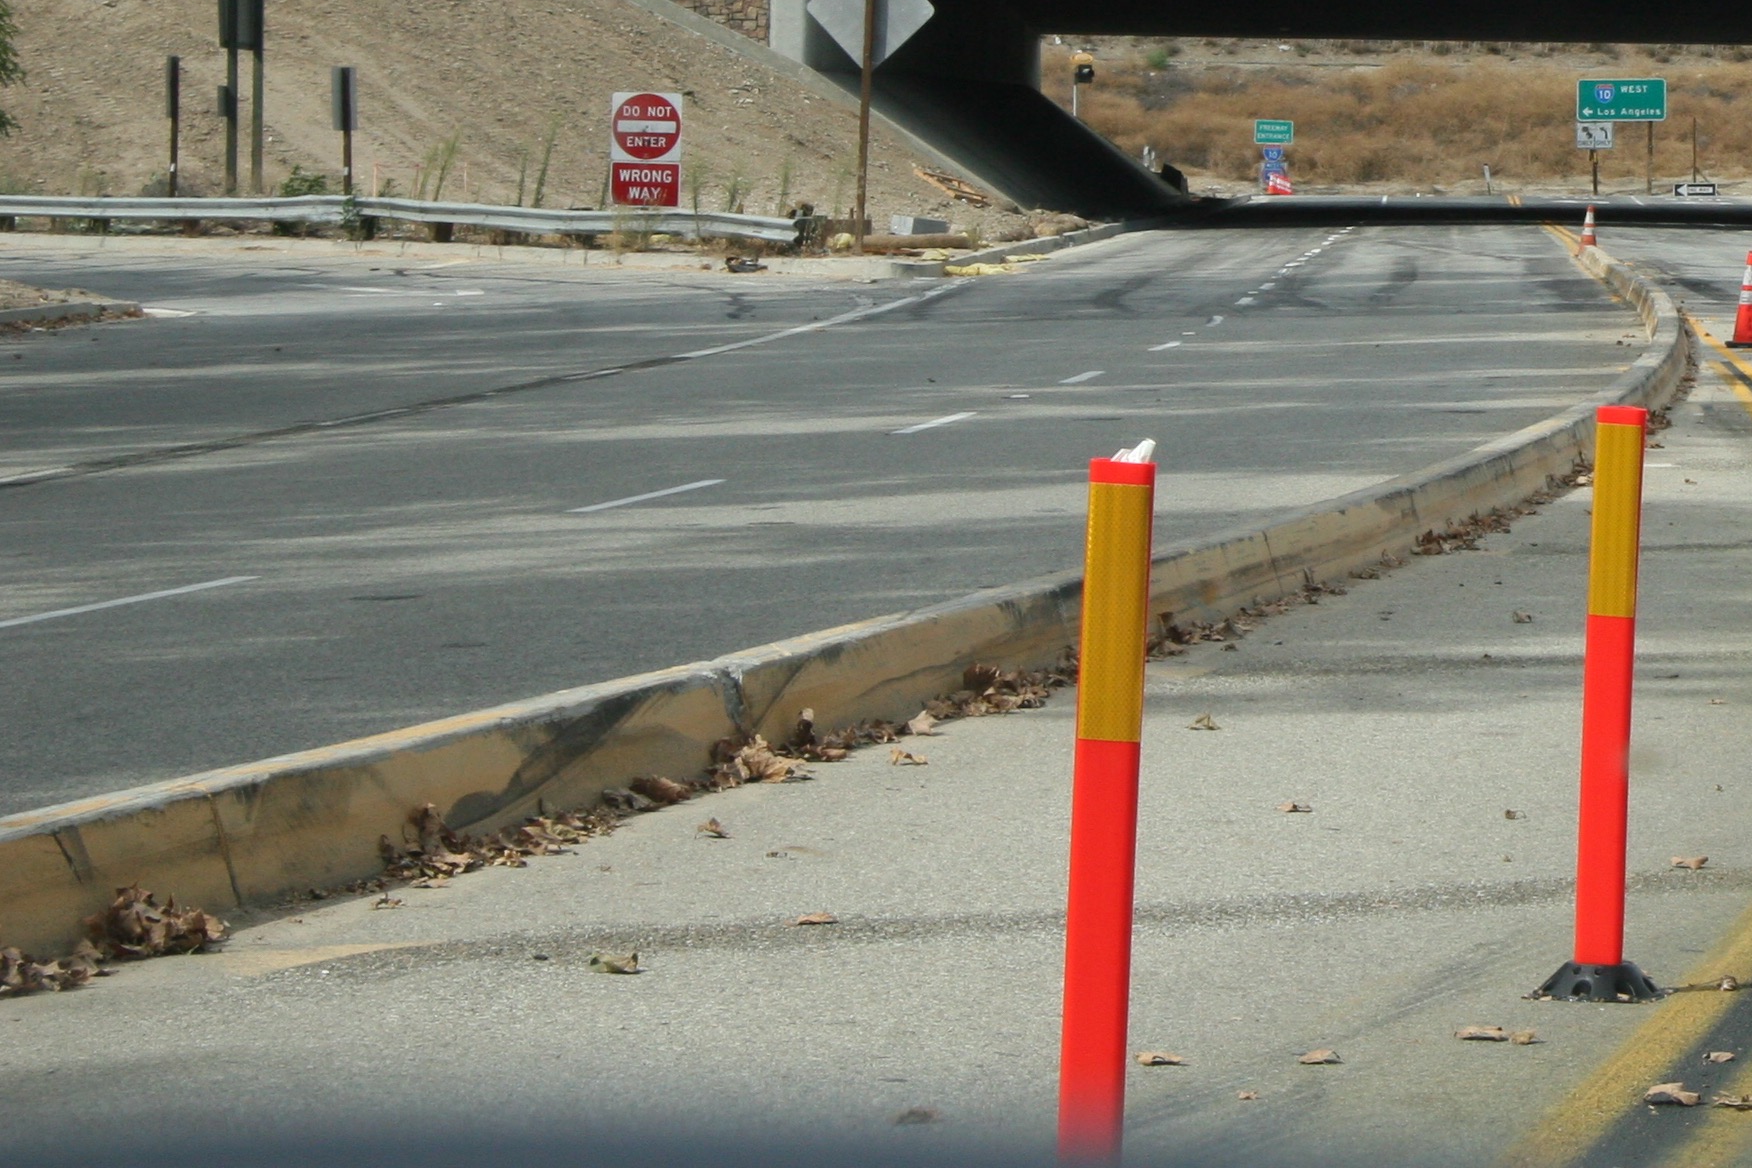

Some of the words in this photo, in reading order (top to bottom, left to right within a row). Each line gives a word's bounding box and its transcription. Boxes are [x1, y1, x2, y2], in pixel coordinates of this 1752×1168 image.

[1599, 90, 1611, 100] 10
[1620, 85, 1648, 94] WEST
[622, 106, 640, 117] DO
[647, 106, 672, 118] NOT
[1597, 107, 1616, 116] Los
[1620, 107, 1661, 117] Angeles
[626, 136, 667, 148] ENTER
[619, 169, 672, 184] WRONG
[628, 187, 661, 200] WAY
